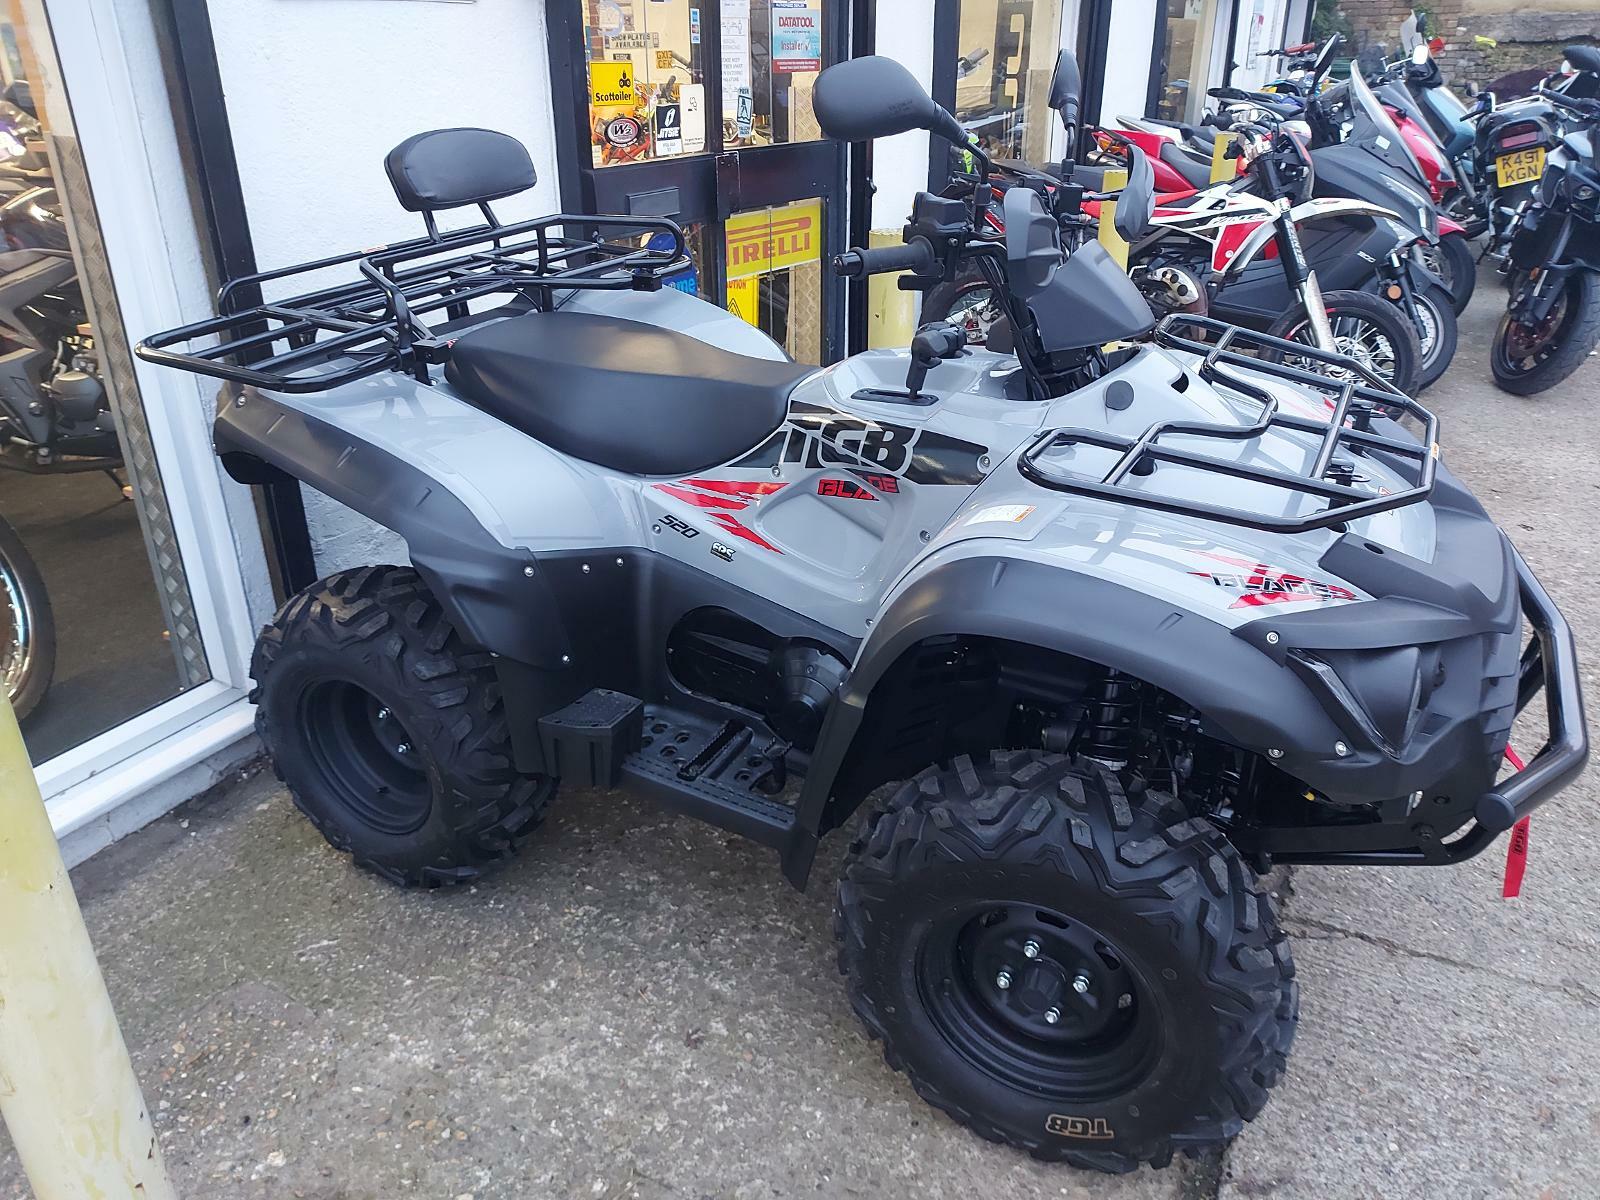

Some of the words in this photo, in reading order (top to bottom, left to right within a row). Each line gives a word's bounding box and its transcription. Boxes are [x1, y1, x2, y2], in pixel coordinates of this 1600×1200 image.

[778, 16, 815, 28] DATATOOL
[780, 40, 804, 51] Installer
[595, 91, 632, 103] Scottoiler
[1505, 165, 1538, 183] KGN
[727, 280, 747, 290] UTION
[780, 417, 921, 476] TGB
[658, 514, 700, 539] 520
[711, 541, 736, 558] EPS
[1210, 572, 1332, 599] BLADE
[1045, 1113, 1115, 1140] TGB
